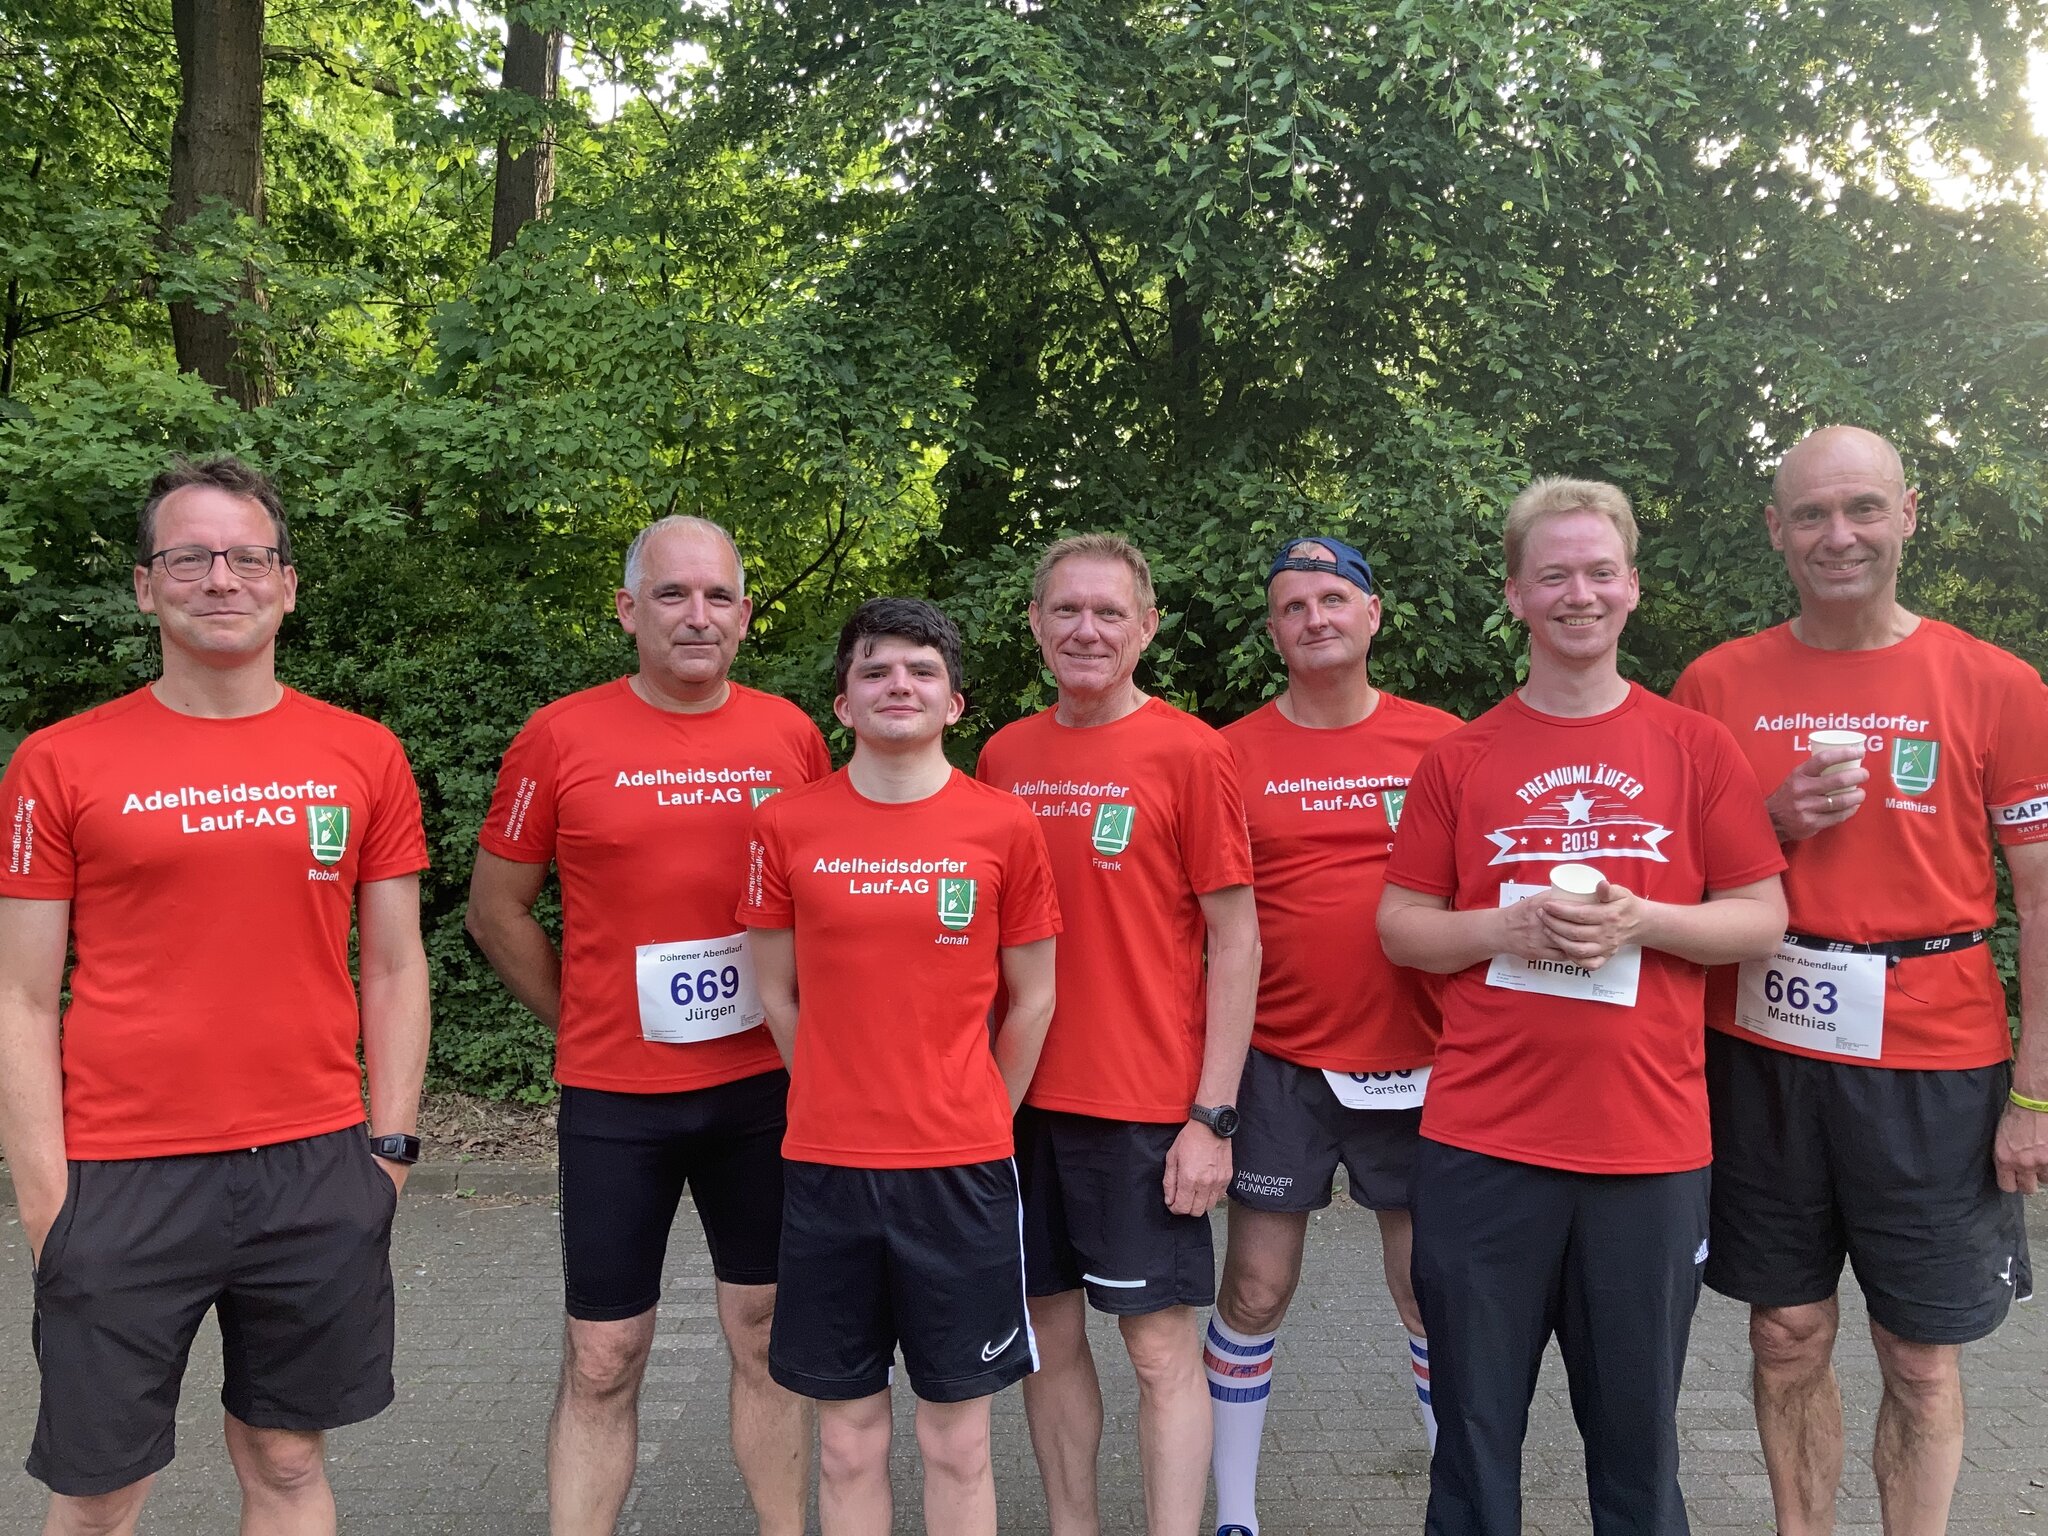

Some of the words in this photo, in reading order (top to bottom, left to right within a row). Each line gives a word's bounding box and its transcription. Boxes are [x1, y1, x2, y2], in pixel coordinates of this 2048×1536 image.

[1754, 713, 1929, 733] Adelheidsdorfer
[614, 767, 773, 788] Adelheidsdorfer
[1264, 775, 1412, 796] Adelheidsdorfer
[1516, 763, 1645, 805] PREMIUMLÄUFER
[121, 780, 338, 815] Adelheidsdorfer
[657, 788, 742, 807] Lauf-AG
[1011, 780, 1130, 798] Adelheidsdorfer
[504, 799, 521, 838] Unterstützt
[516, 777, 529, 798] durch
[1031, 801, 1092, 817] Lauf-AG
[1301, 793, 1378, 811] Lauf-AG
[1885, 797, 1937, 814] Matthias
[182, 806, 296, 835] Lauf-AG
[2016, 824, 2040, 834] SAYS
[9, 823, 22, 873] Unterstützt
[1562, 830, 1599, 852] 2019
[813, 858, 967, 874] Adelheidsdorfer
[1092, 858, 1122, 871] Frank
[307, 868, 340, 882] Robert
[849, 879, 930, 895] Lauf-AG
[934, 933, 970, 946] Jonah
[1924, 938, 1951, 951] cep
[659, 952, 701, 962] Döhrener
[703, 943, 743, 959] Abendlauf
[1797, 958, 1848, 972] Abendlauf
[670, 965, 740, 1006] 669
[1764, 969, 1839, 1015] 663
[684, 1004, 736, 1022] Jürgen
[1767, 1005, 1837, 1033] Matthias
[1363, 1083, 1417, 1095] Carsten
[1237, 1169, 1294, 1187] HANNOVER
[1236, 1180, 1285, 1197] RUNNERS
